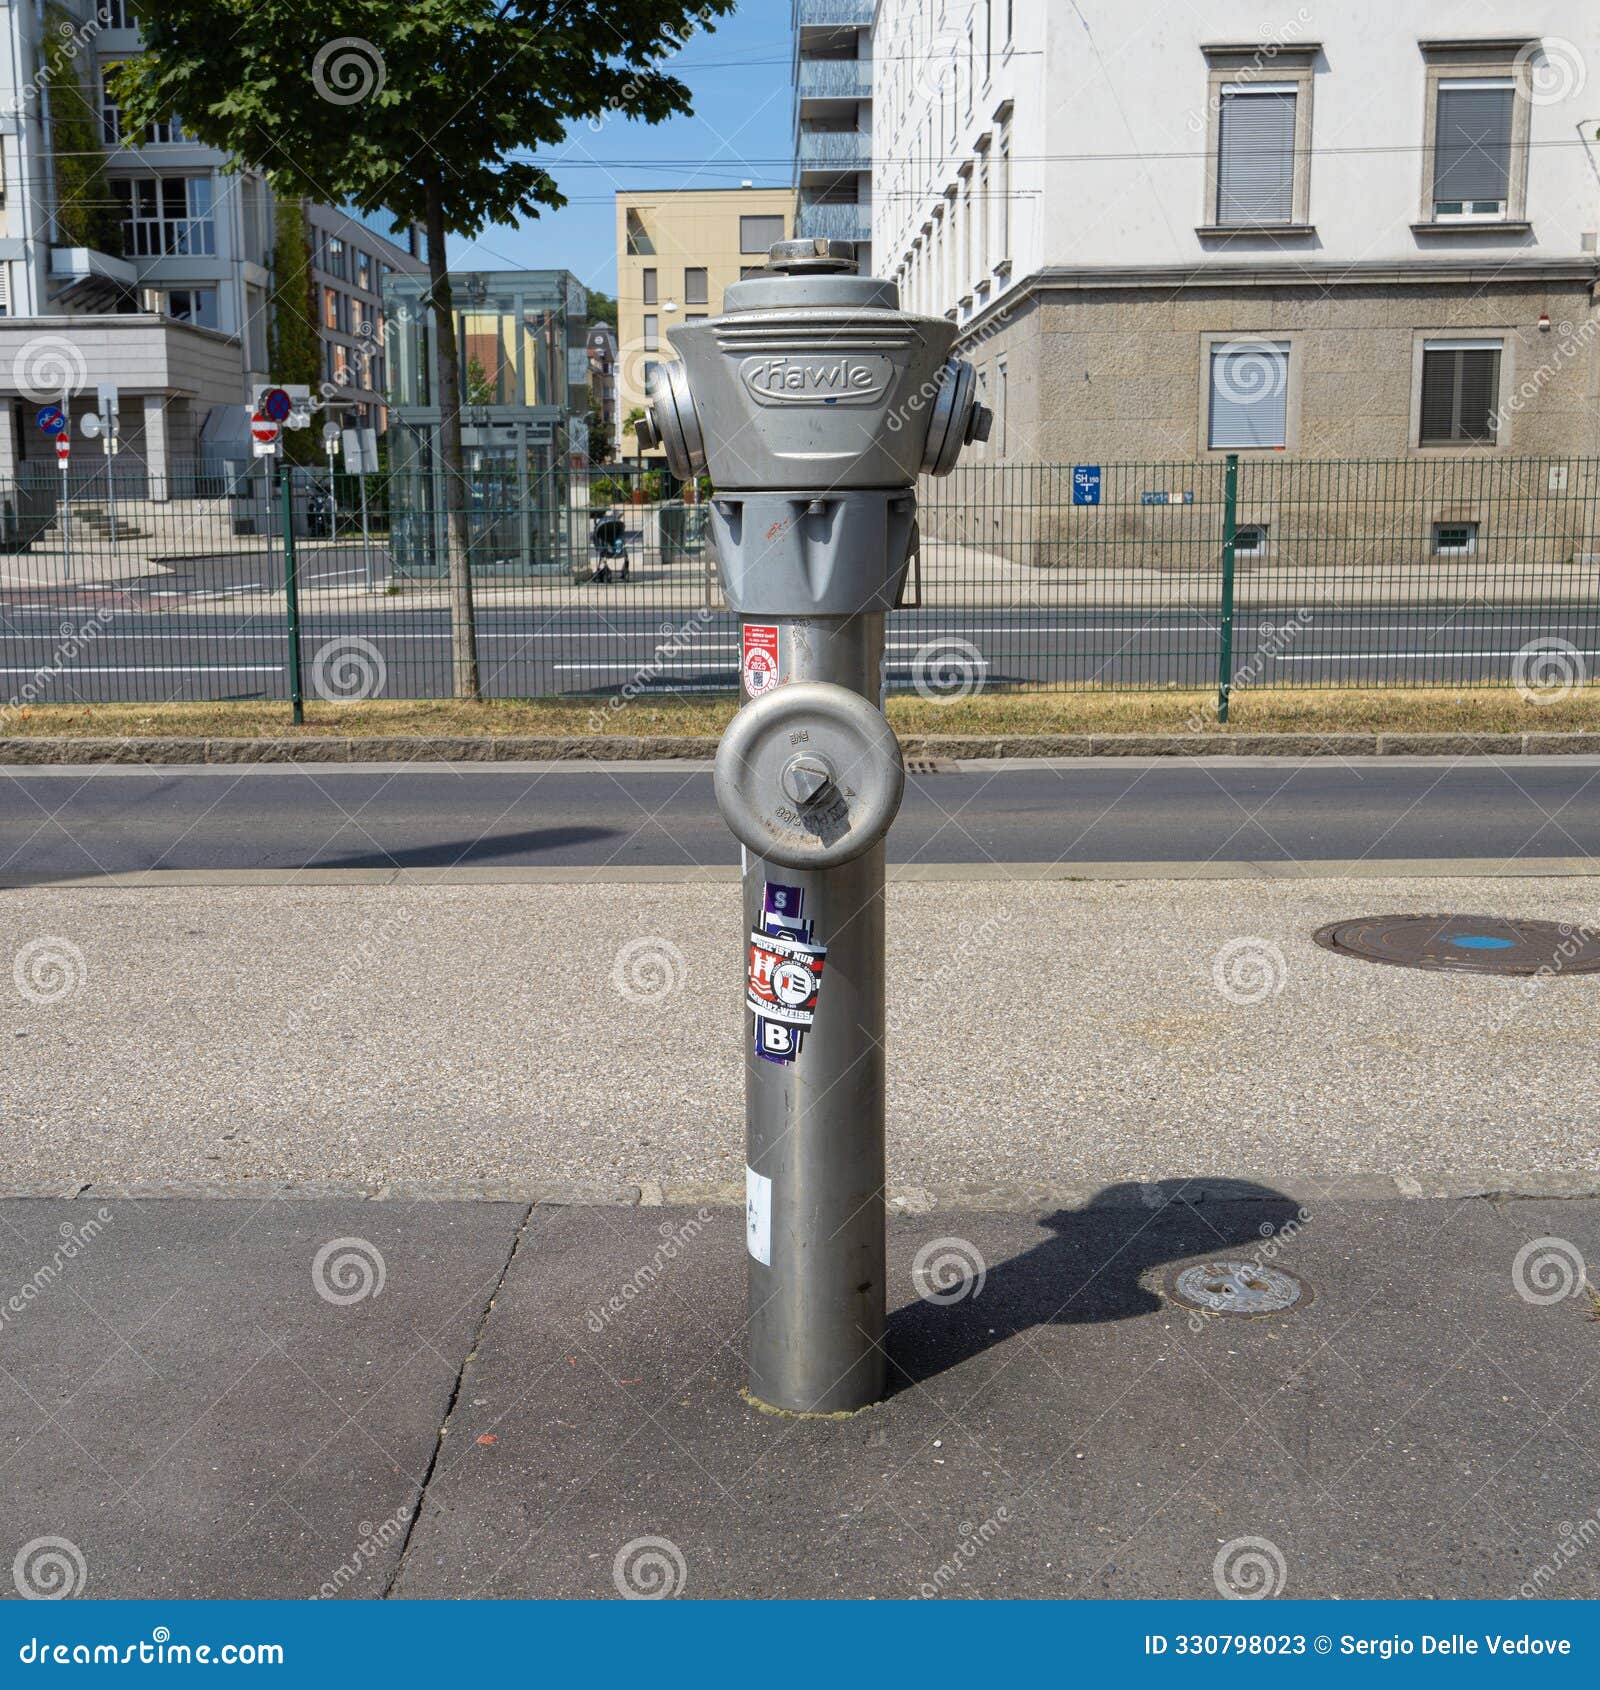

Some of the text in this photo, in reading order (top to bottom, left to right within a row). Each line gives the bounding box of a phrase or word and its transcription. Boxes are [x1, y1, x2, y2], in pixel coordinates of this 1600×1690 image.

[1075, 473, 1088, 483] SH
[750, 661, 767, 670] 2025
[792, 952, 814, 965] NUR
[764, 1022, 789, 1050] B
